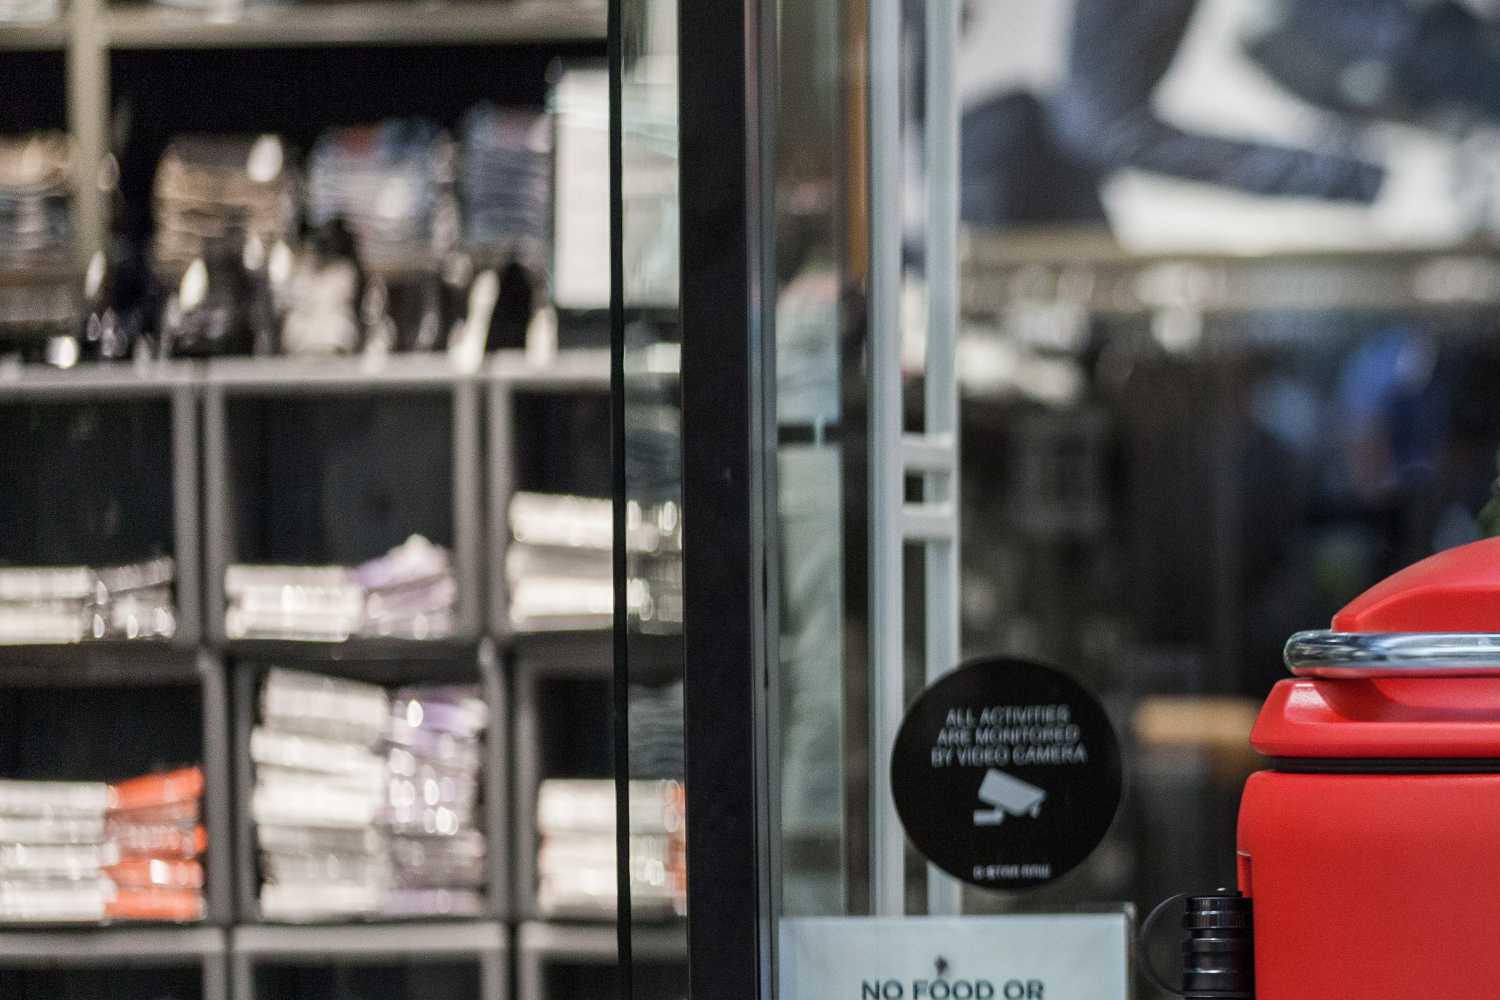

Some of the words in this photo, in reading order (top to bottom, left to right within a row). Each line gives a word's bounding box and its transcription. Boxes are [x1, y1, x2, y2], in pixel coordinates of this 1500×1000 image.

[946, 707, 976, 728] ALL
[980, 704, 1071, 726] ACTIVITIES
[937, 727, 971, 746] ARE
[976, 724, 1081, 745] MONITORED
[931, 746, 954, 767] BY
[957, 744, 1010, 767] VIDEO
[1012, 741, 1088, 765] CAMERA
